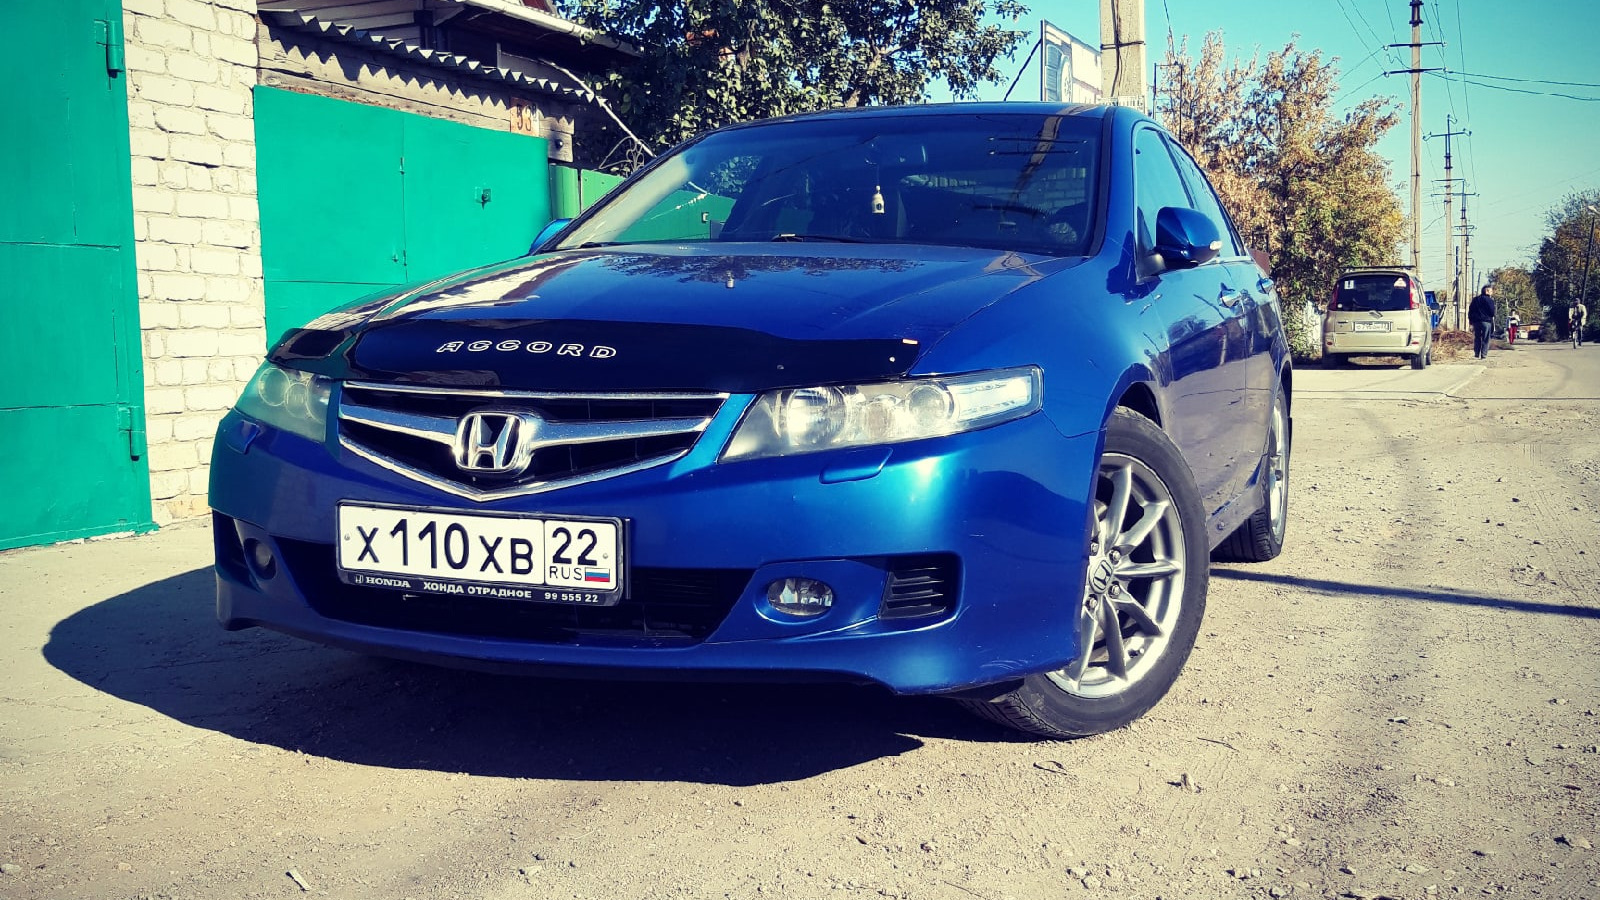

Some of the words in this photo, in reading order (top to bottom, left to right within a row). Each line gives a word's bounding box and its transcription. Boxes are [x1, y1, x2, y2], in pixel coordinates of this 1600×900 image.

[436, 339, 617, 359] ACCORD
[551, 526, 598, 566] 22
[365, 576, 411, 588] HONDA
[549, 565, 583, 581] RUS
[423, 581, 465, 594] ХОНДА
[467, 585, 532, 599] ОТРАДНОЕ
[544, 592, 558, 601] 99
[561, 592, 582, 602] 555
[585, 594, 599, 603] 22
